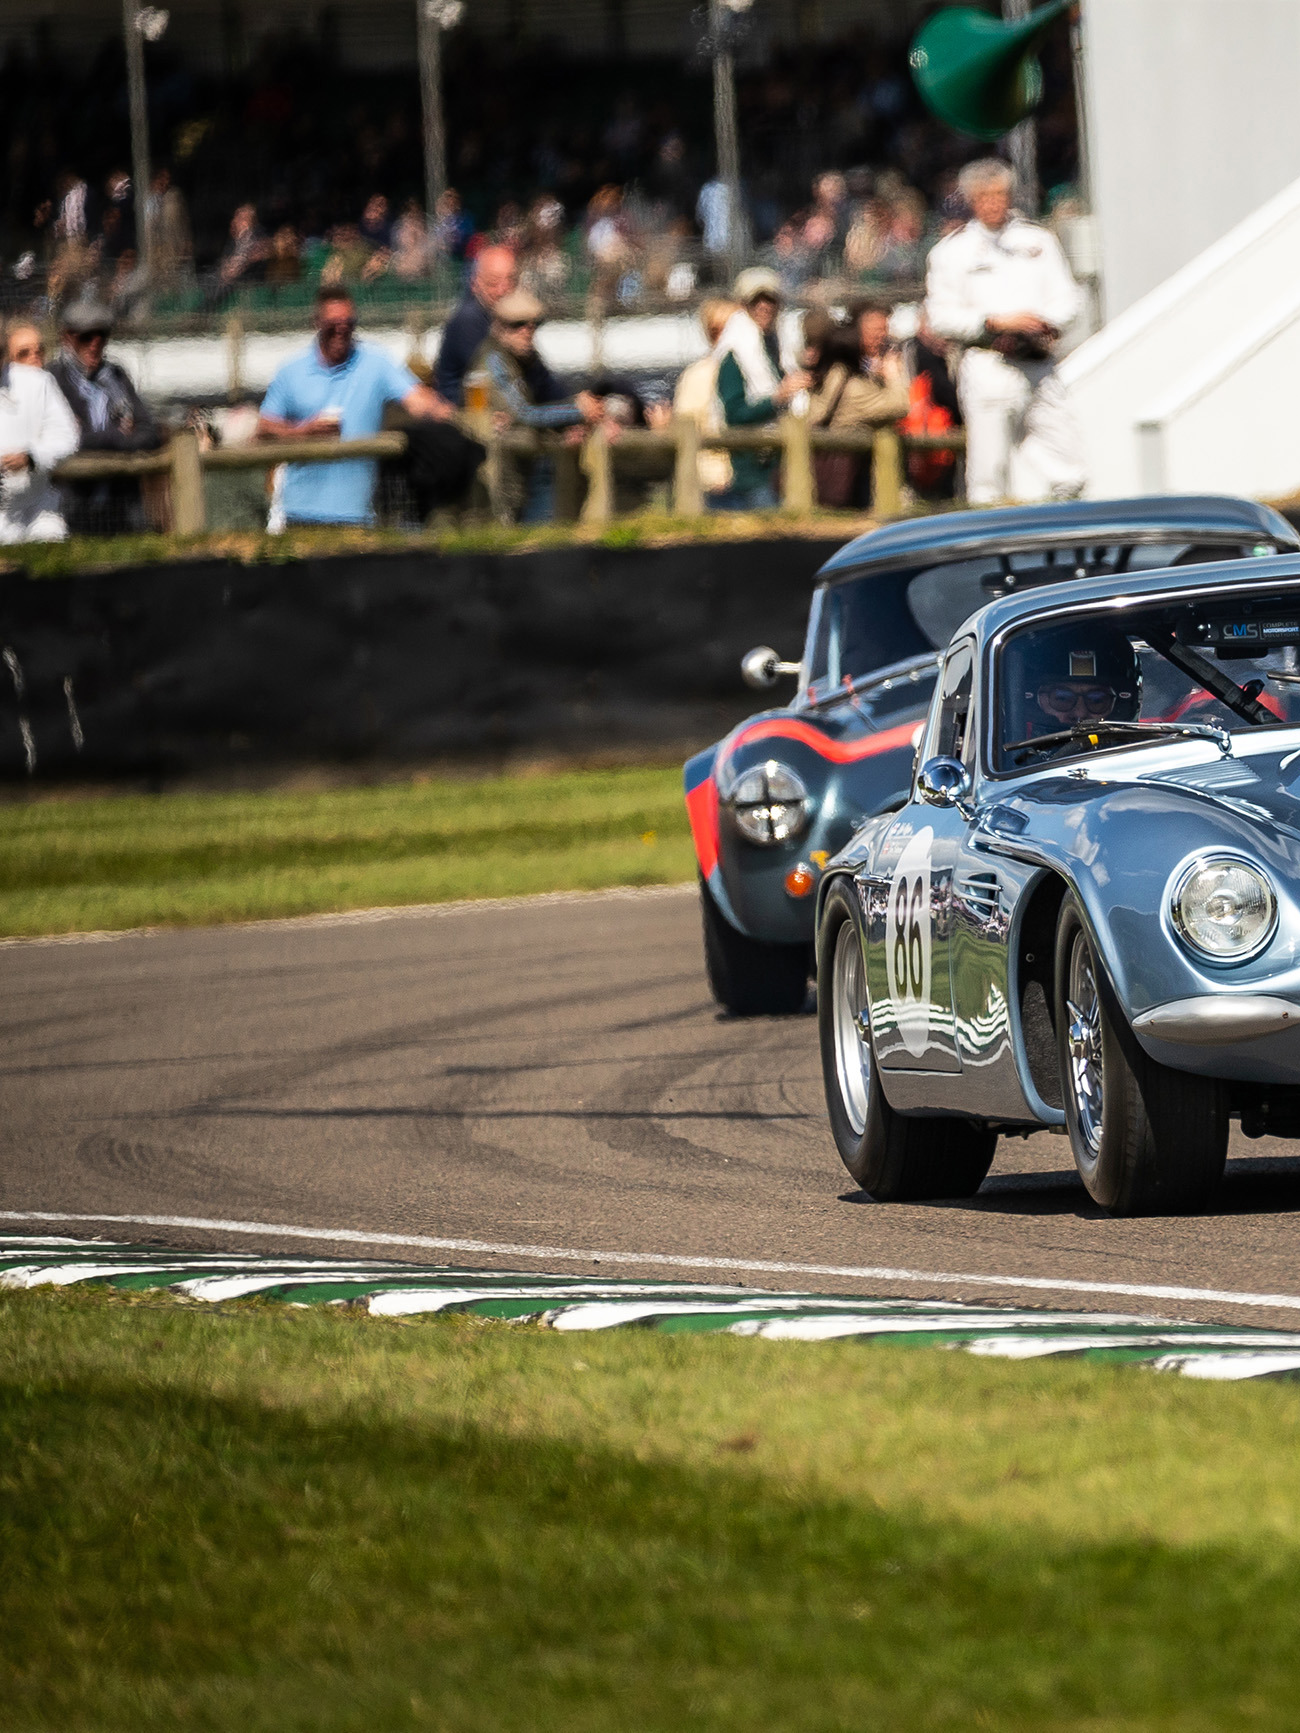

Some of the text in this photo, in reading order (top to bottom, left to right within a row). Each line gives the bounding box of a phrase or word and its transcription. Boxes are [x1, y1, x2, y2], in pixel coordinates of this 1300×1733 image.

[1223, 623, 1258, 640] CMS
[1262, 626, 1300, 634] MOTORSPORT
[894, 876, 923, 1002] 86
